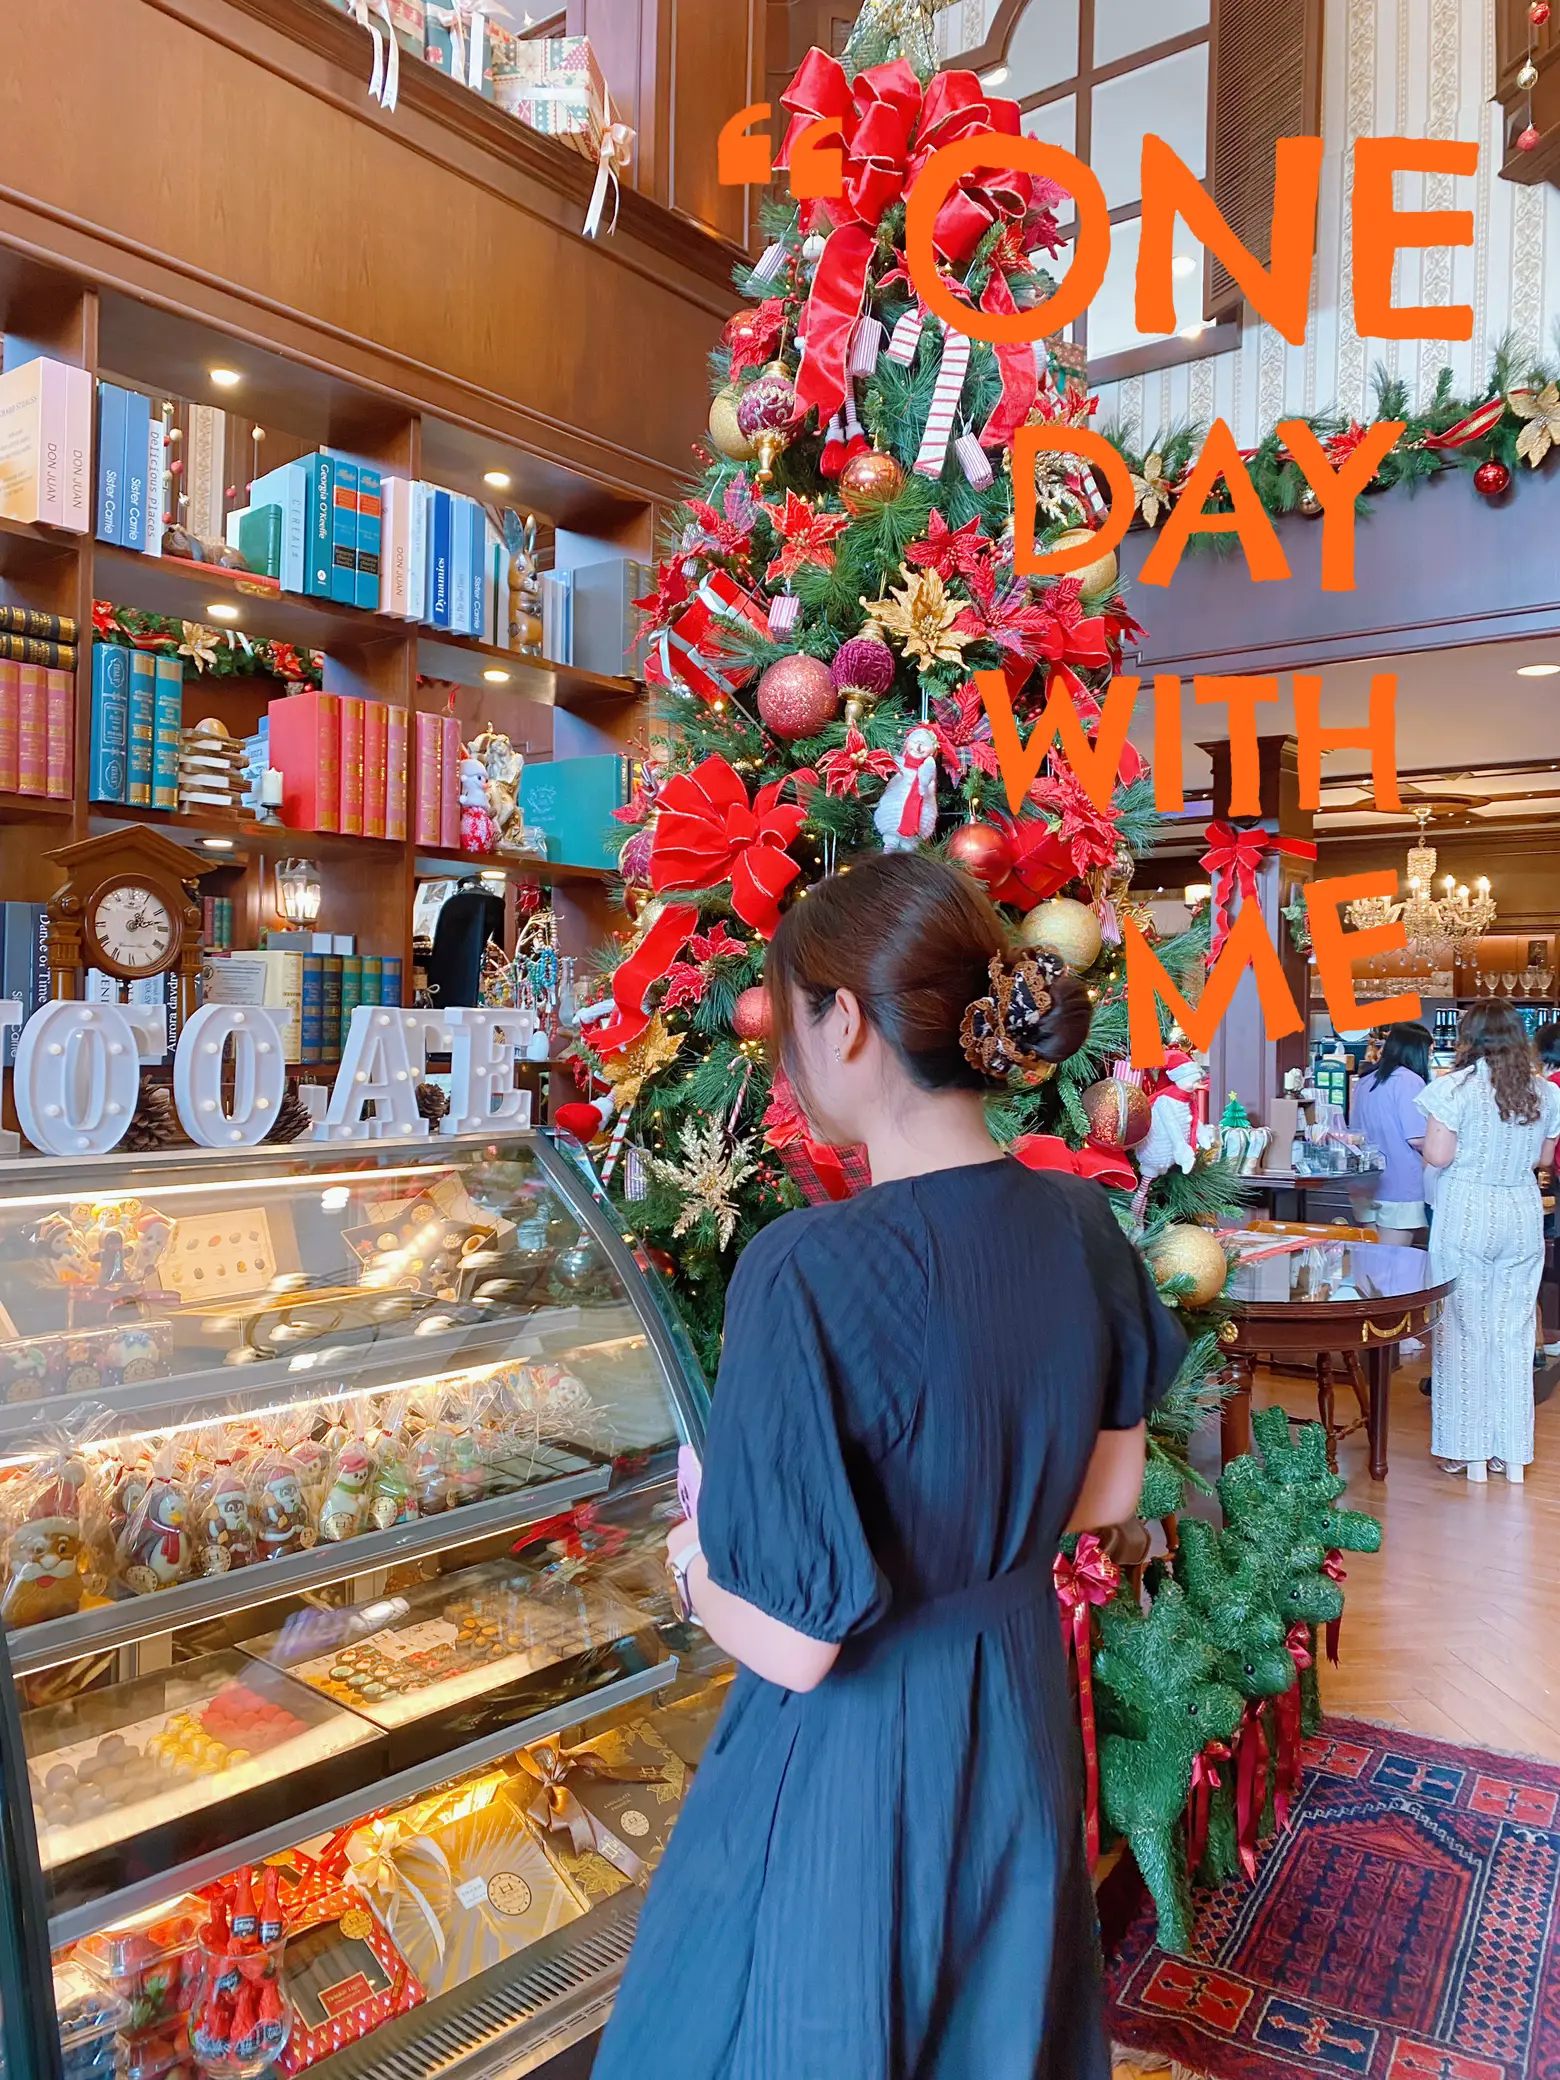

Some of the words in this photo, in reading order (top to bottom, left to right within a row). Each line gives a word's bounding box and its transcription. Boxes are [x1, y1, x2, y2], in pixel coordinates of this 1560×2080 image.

[47, 442, 57, 469] DON
[73, 449, 83, 476] DON
[149, 431, 160, 491] Delicious
[47, 470, 56, 502] JUAN
[72, 477, 82, 509] JUAN
[106, 469, 117, 499] Sister
[130, 477, 141, 506] Sister
[317, 463, 330, 499] Georgia
[104, 501, 116, 534] Carrie
[128, 508, 140, 541] Carrie
[317, 502, 328, 539] O'Keeffe
[435, 557, 446, 613] Dynamics
[473, 575, 482, 599] Sister
[472, 601, 481, 629] Carrie
[38, 914, 51, 952] Dance
[38, 970, 52, 1003] Time
[167, 1011, 178, 1052] Aurora
